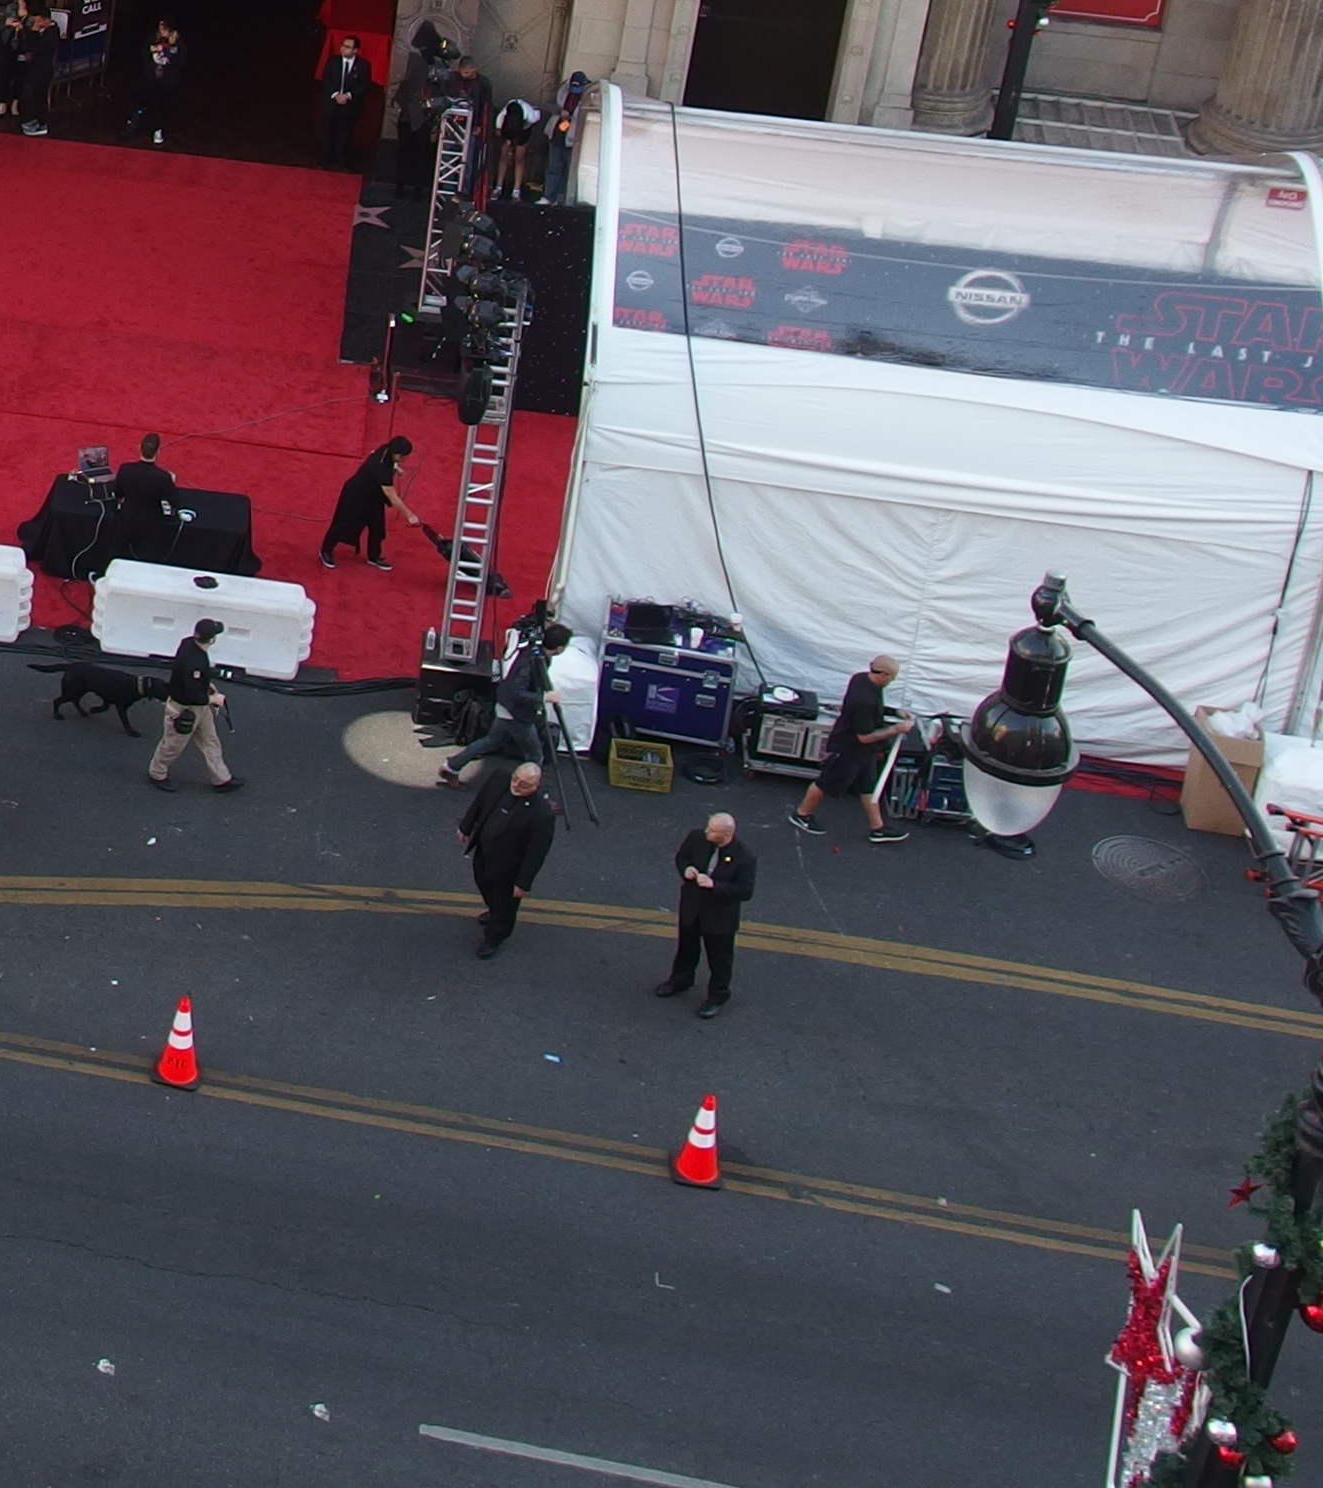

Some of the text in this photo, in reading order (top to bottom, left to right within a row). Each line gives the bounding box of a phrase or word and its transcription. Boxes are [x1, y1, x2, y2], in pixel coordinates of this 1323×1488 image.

[81, 2, 103, 15] CALL
[955, 289, 1024, 307] NISSAN
[1095, 330, 1273, 364] THE LAST
